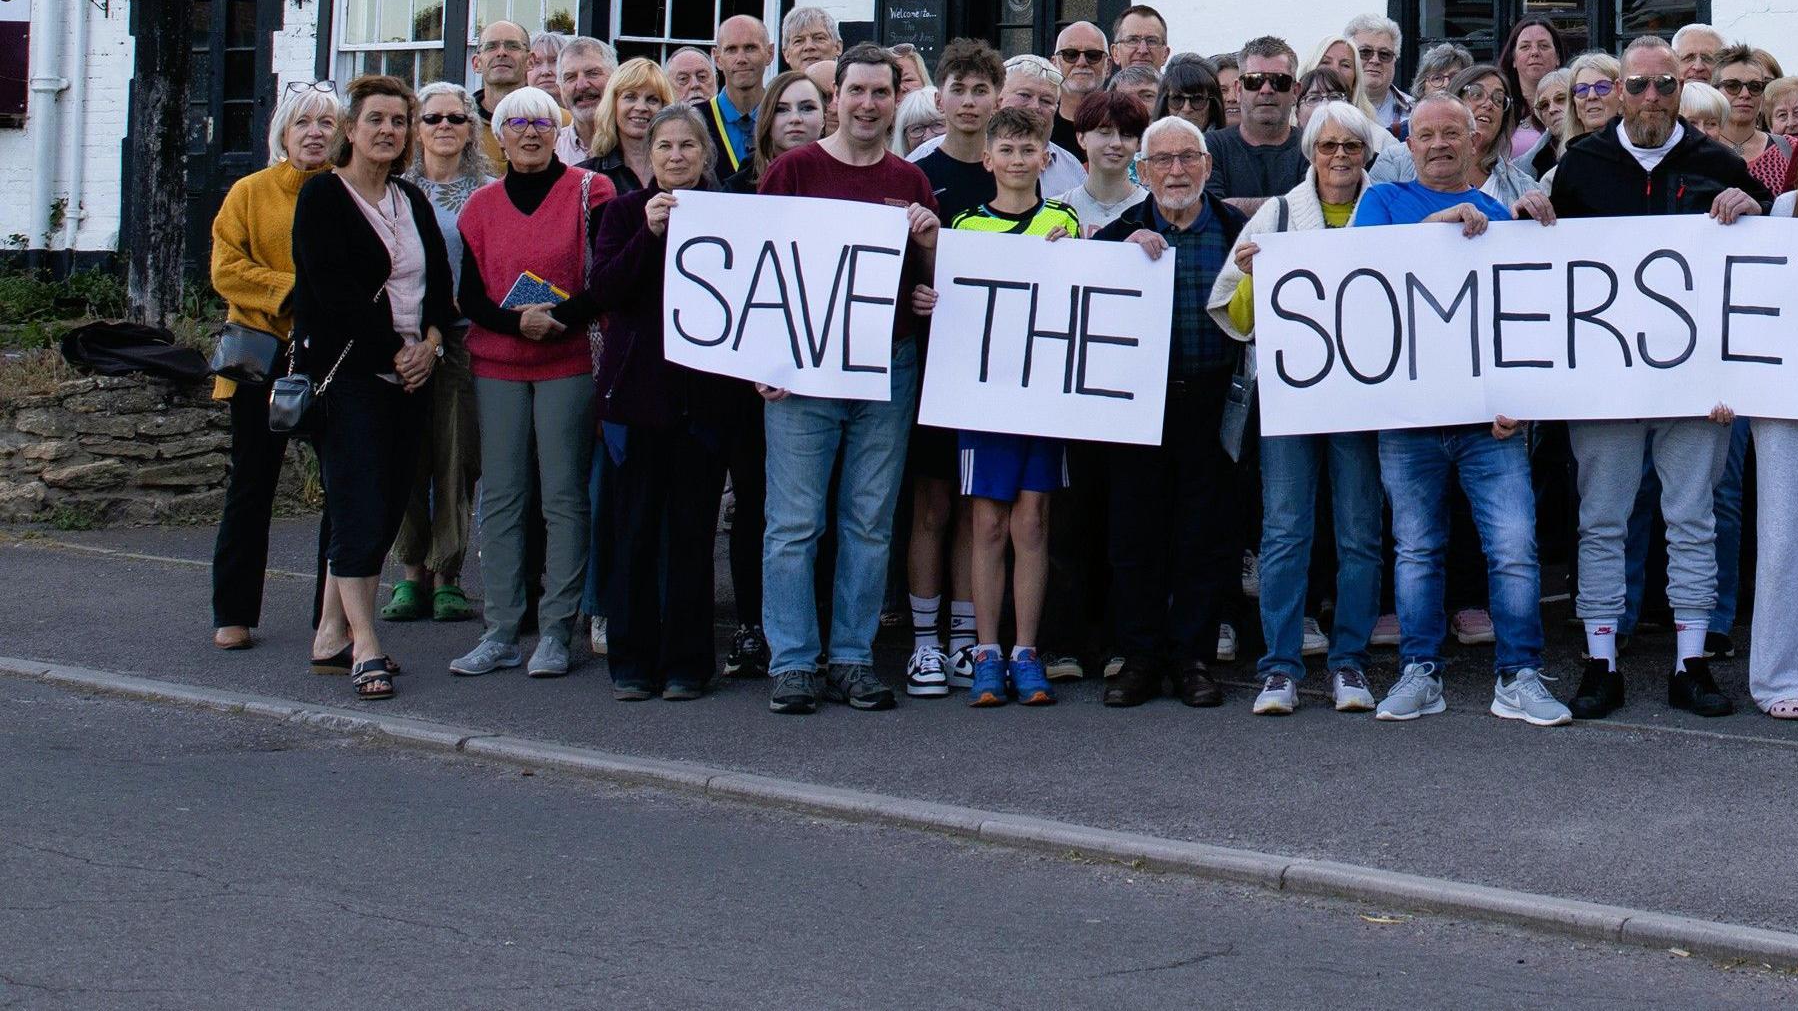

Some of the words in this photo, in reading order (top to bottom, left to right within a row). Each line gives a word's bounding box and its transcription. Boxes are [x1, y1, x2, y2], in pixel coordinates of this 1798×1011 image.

[889, 7, 920, 19] Welcome
[673, 235, 901, 374] SAVE
[953, 276, 1143, 401] THE
